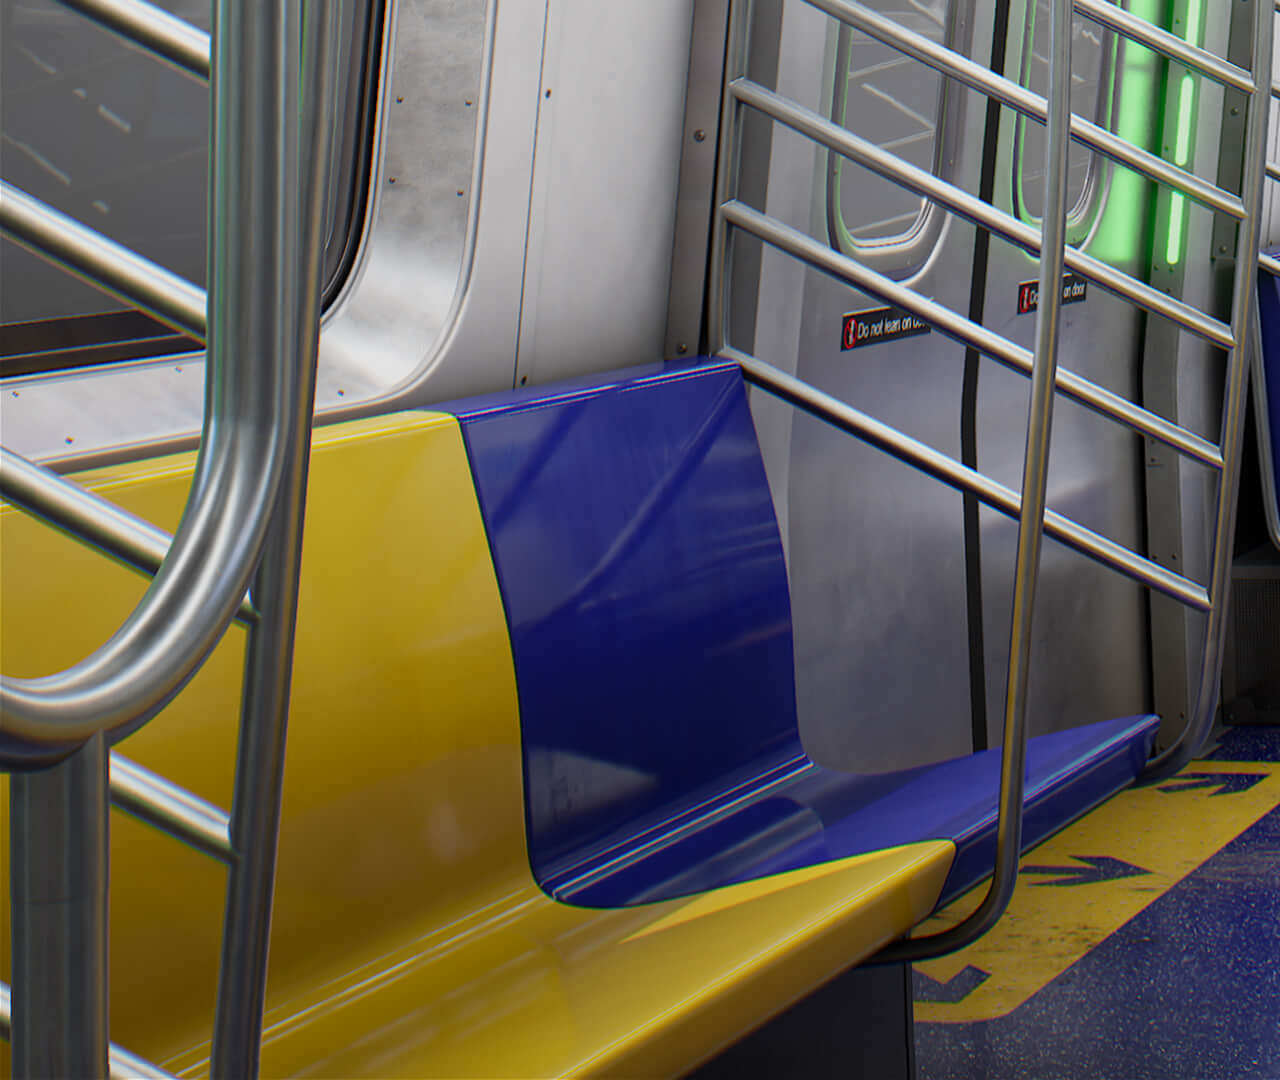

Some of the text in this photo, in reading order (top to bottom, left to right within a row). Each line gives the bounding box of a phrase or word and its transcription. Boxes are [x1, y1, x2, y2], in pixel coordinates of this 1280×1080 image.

[857, 321, 869, 339] Do
[870, 318, 883, 337] not
[902, 315, 912, 329] on
